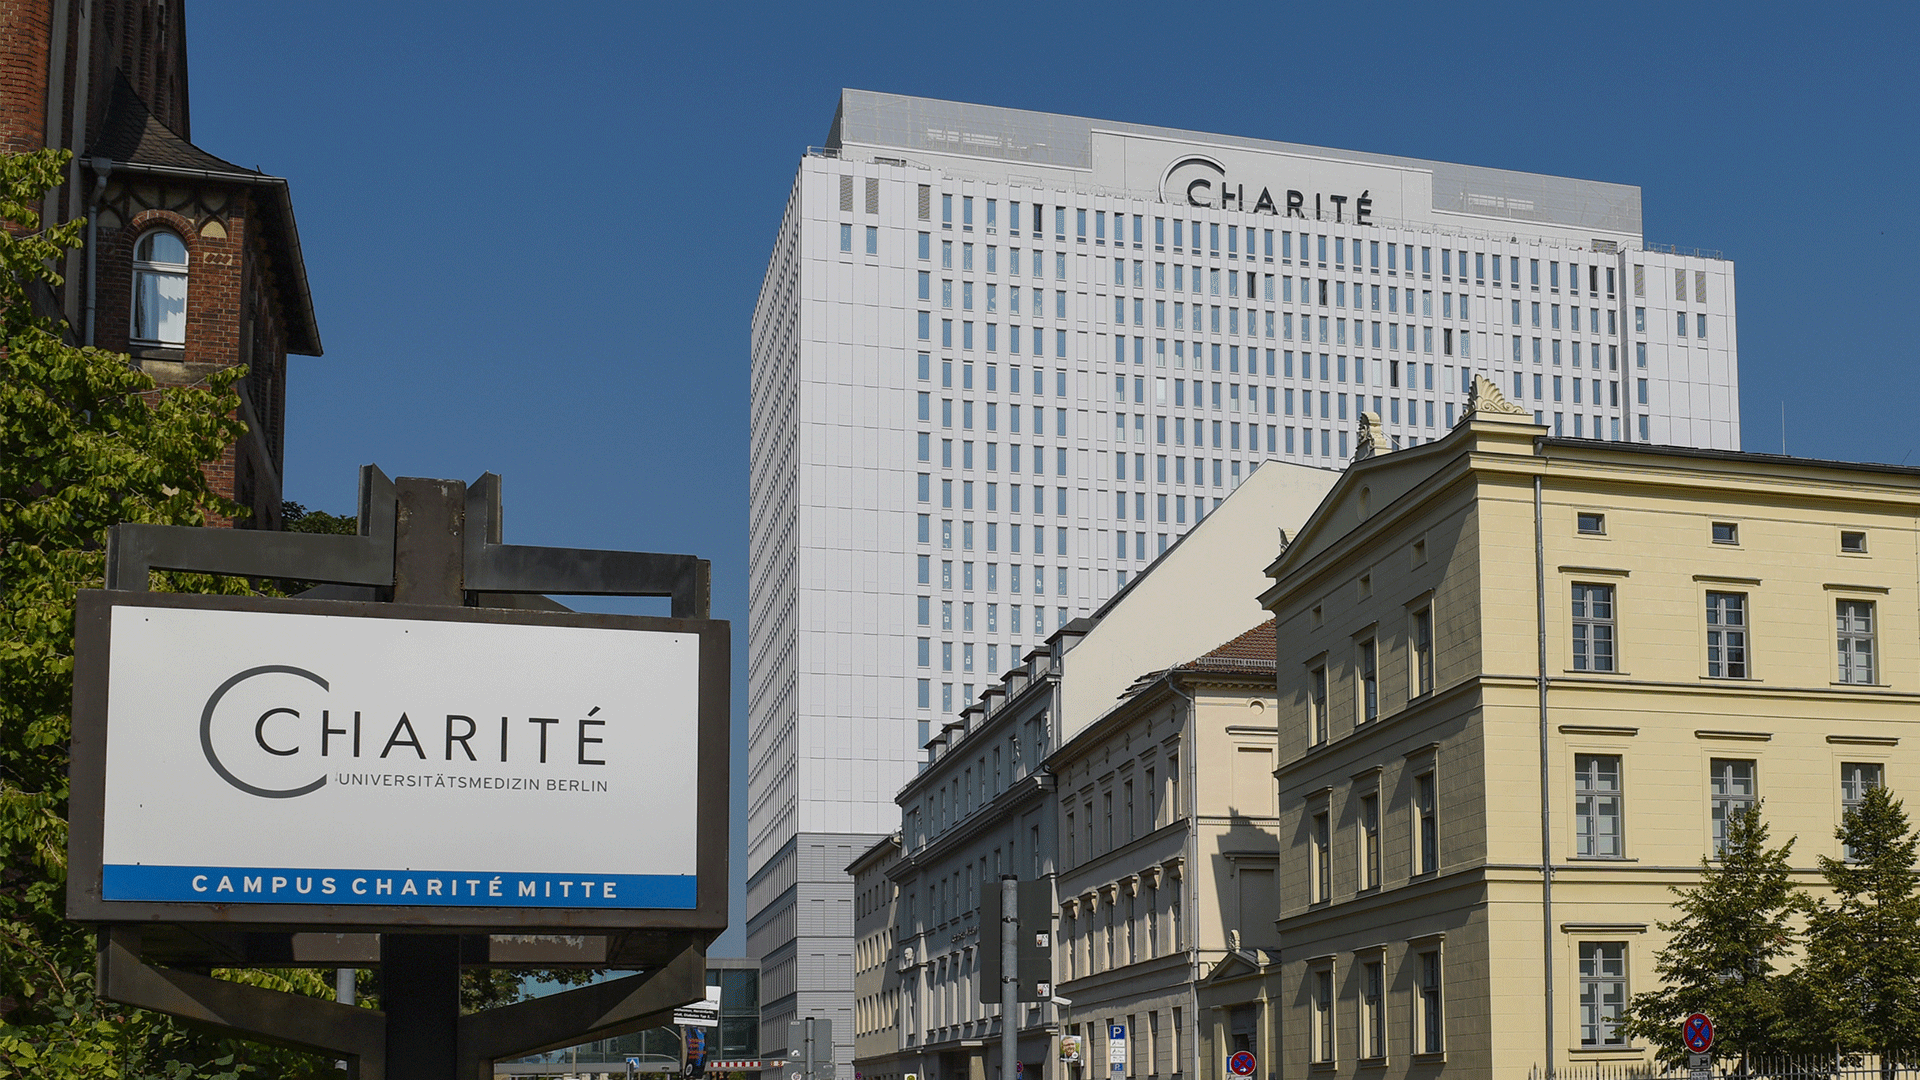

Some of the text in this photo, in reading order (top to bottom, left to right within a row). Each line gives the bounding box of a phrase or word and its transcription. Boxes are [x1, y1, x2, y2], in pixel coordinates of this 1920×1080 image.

[1187, 178, 1373, 226] CHARITÉ
[254, 705, 606, 766] CHARITÉ
[338, 772, 608, 793] UNIVERSITÄTSMEDIZIN BERLIN
[192, 874, 617, 899] CAMPUS CHARITÉ MITTE
[1113, 1026, 1122, 1038] P
